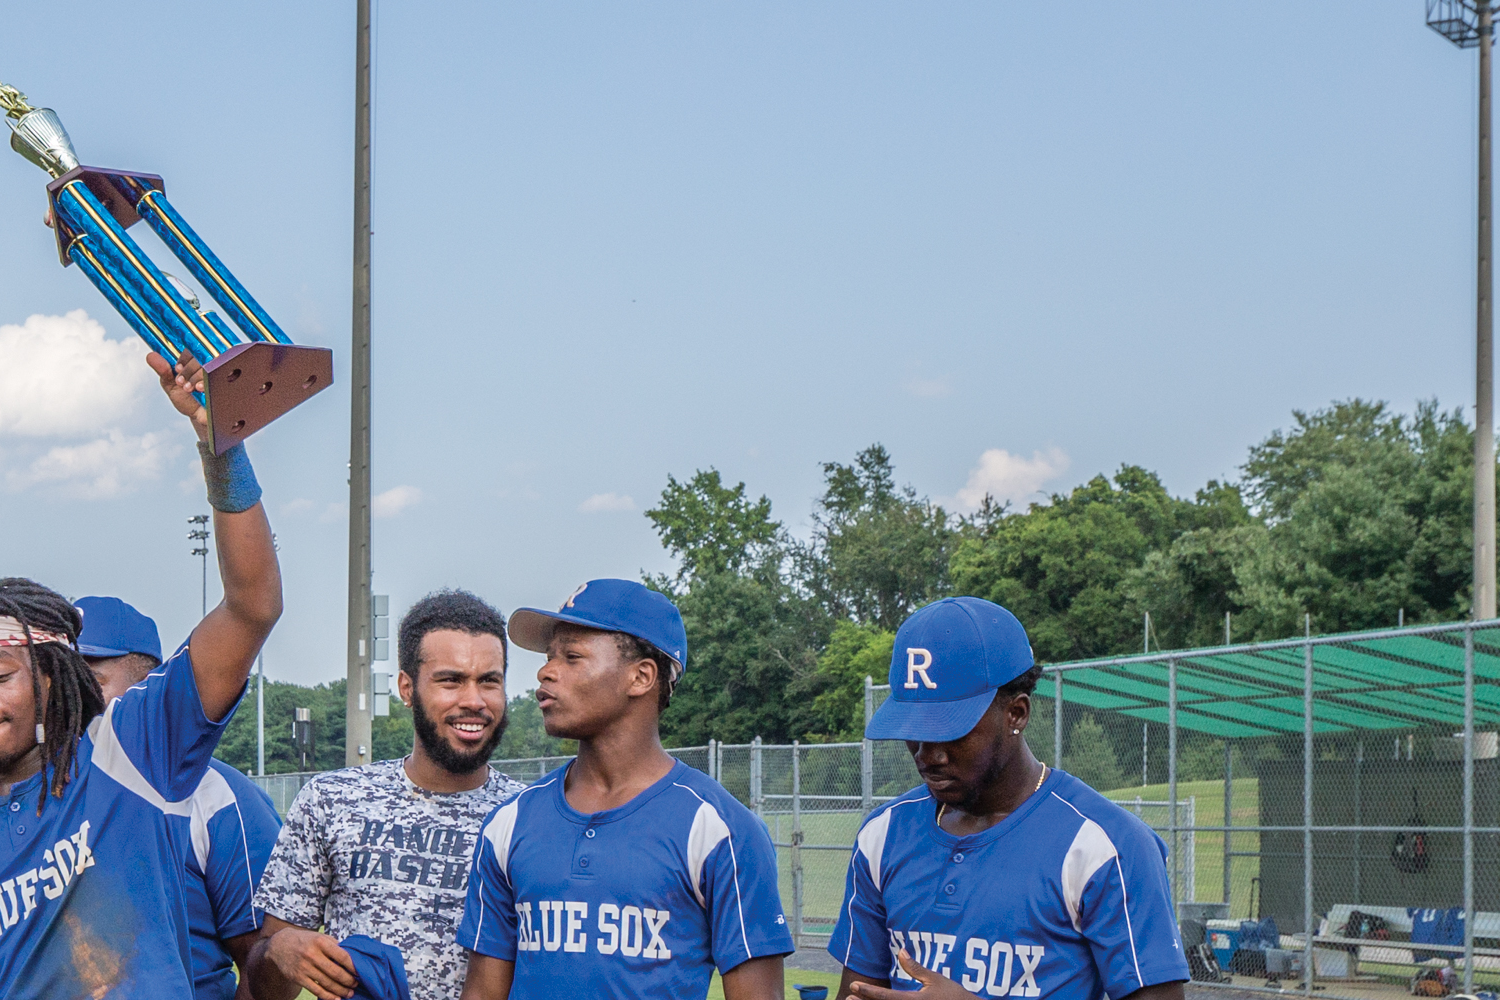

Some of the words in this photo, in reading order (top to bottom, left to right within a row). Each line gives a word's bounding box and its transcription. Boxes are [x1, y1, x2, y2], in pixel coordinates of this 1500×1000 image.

[903, 647, 937, 689] R
[38, 819, 96, 900] SOX
[349, 850, 469, 890] BASEB
[597, 903, 672, 960] SOX
[961, 937, 1045, 998] SOX
